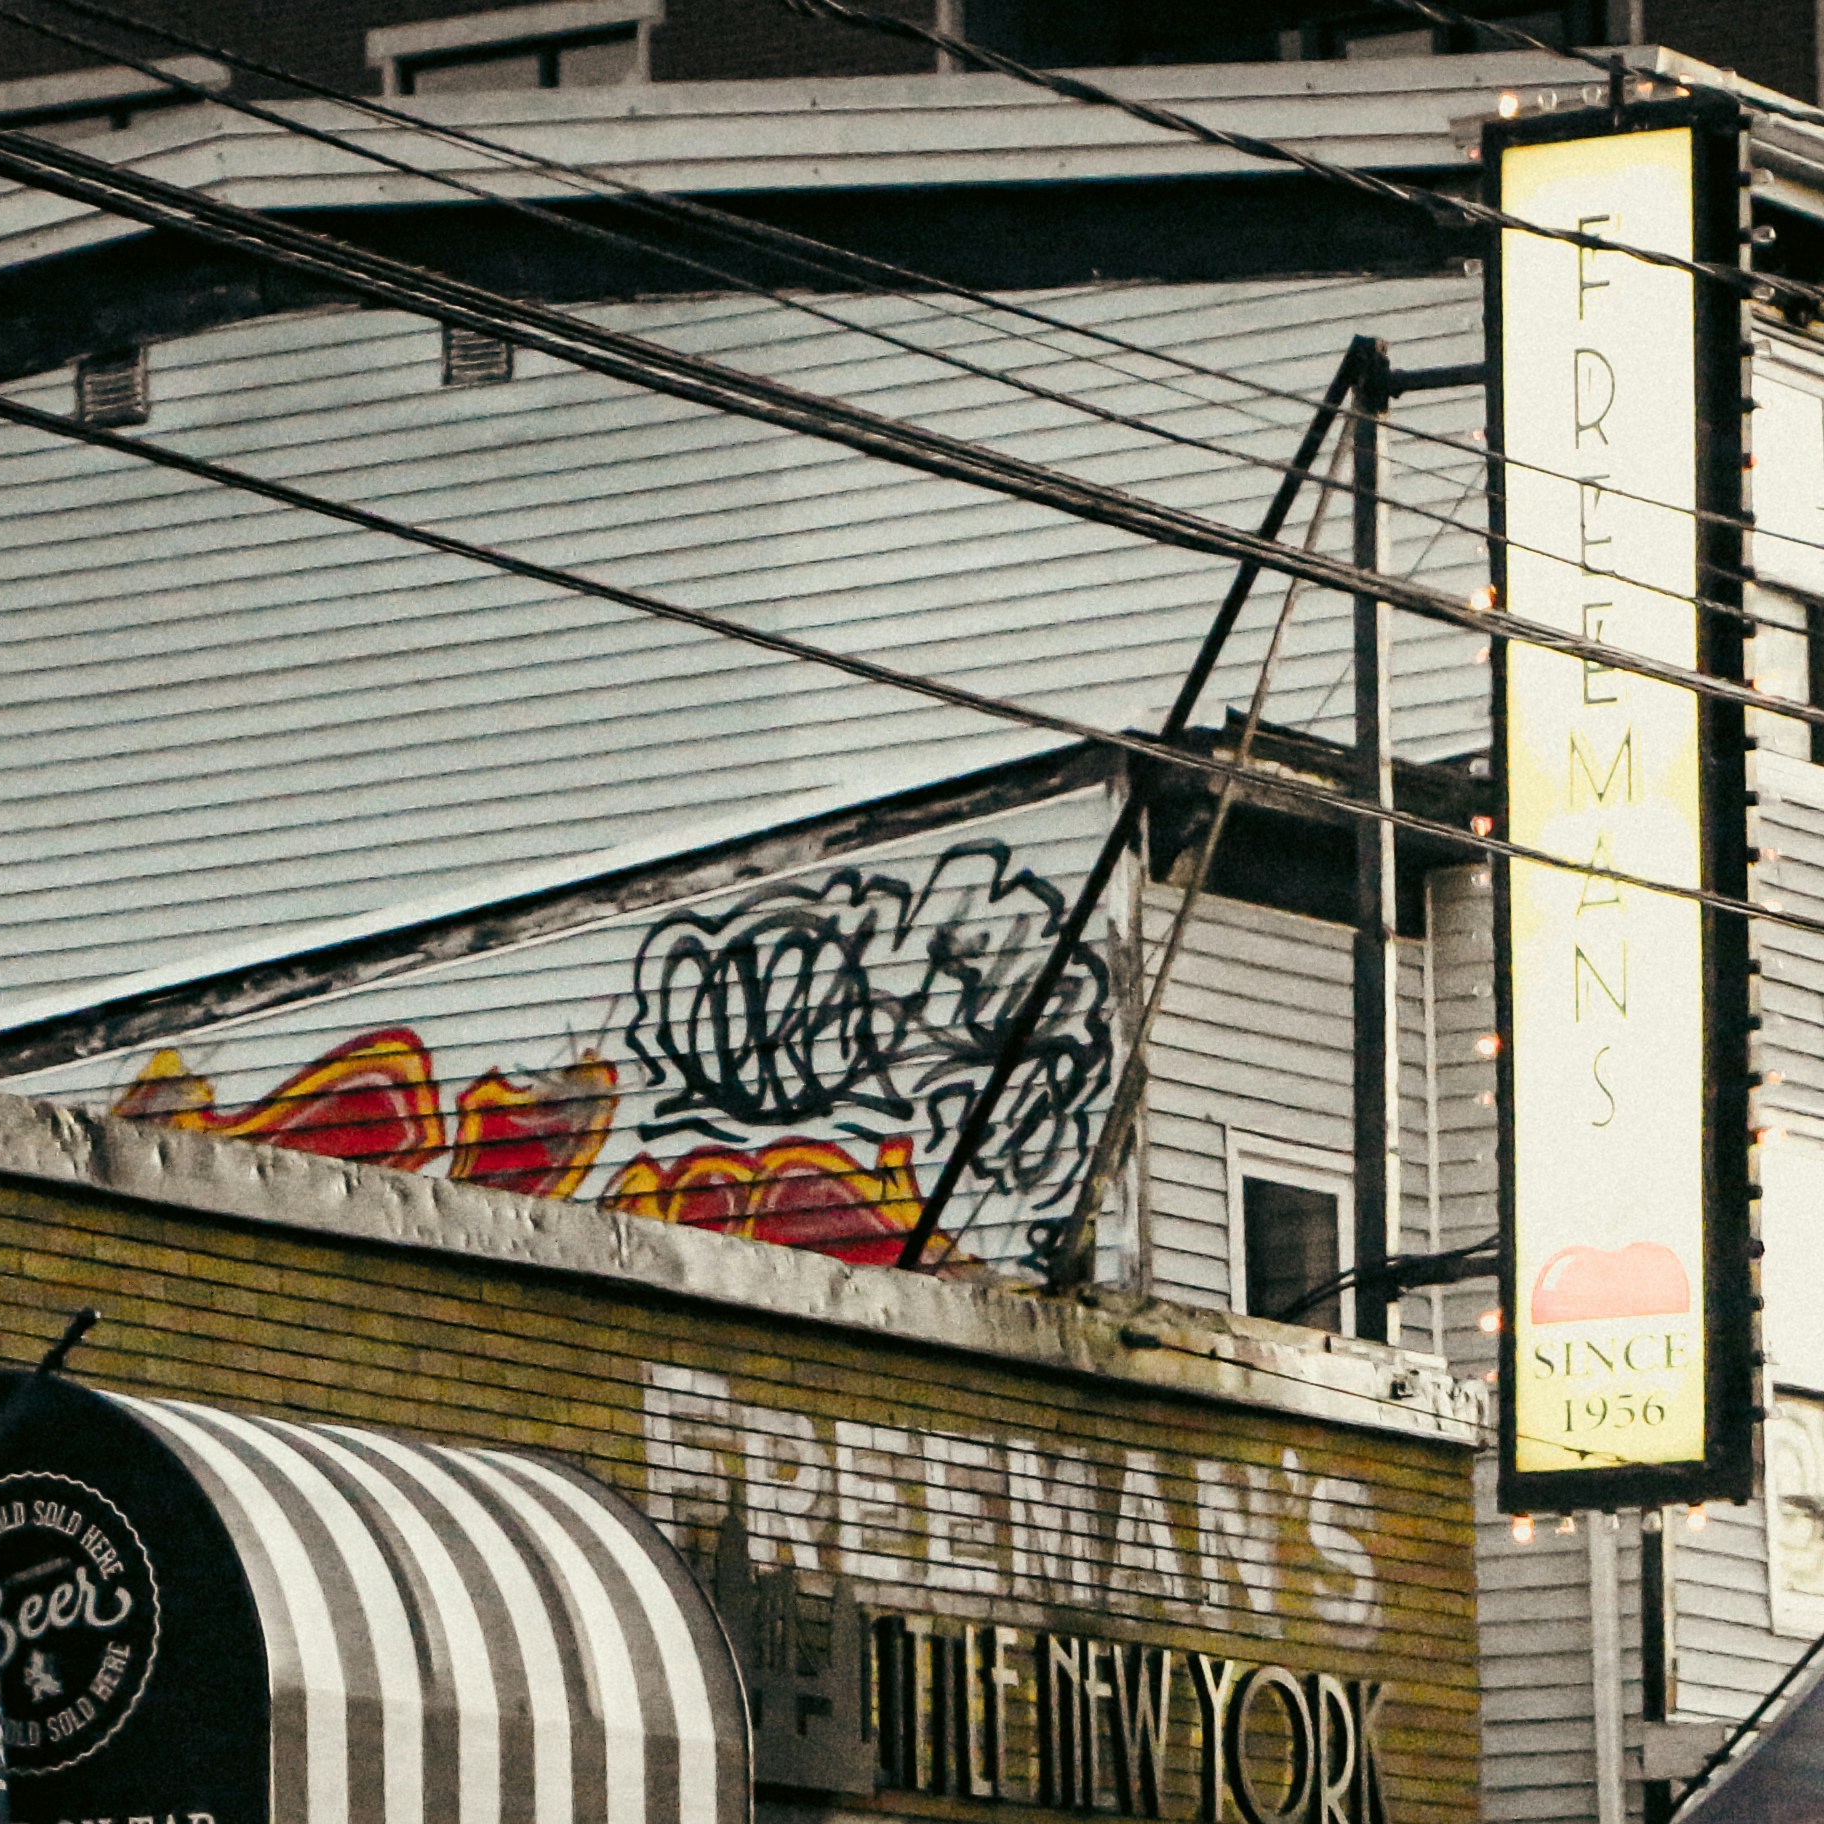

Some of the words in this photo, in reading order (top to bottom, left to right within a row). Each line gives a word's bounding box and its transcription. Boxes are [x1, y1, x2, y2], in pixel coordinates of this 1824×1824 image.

[1533, 1332, 1690, 1382] SINCE
[1561, 1393, 1667, 1434] 1956
[642, 1361, 1376, 1640] FREEMAN'S
[33, 1500, 82, 1536] SOLD
[79, 1524, 125, 1581] HERE
[47, 1697, 97, 1743] SOLD
[1040, 1632, 1172, 1816] NEW
